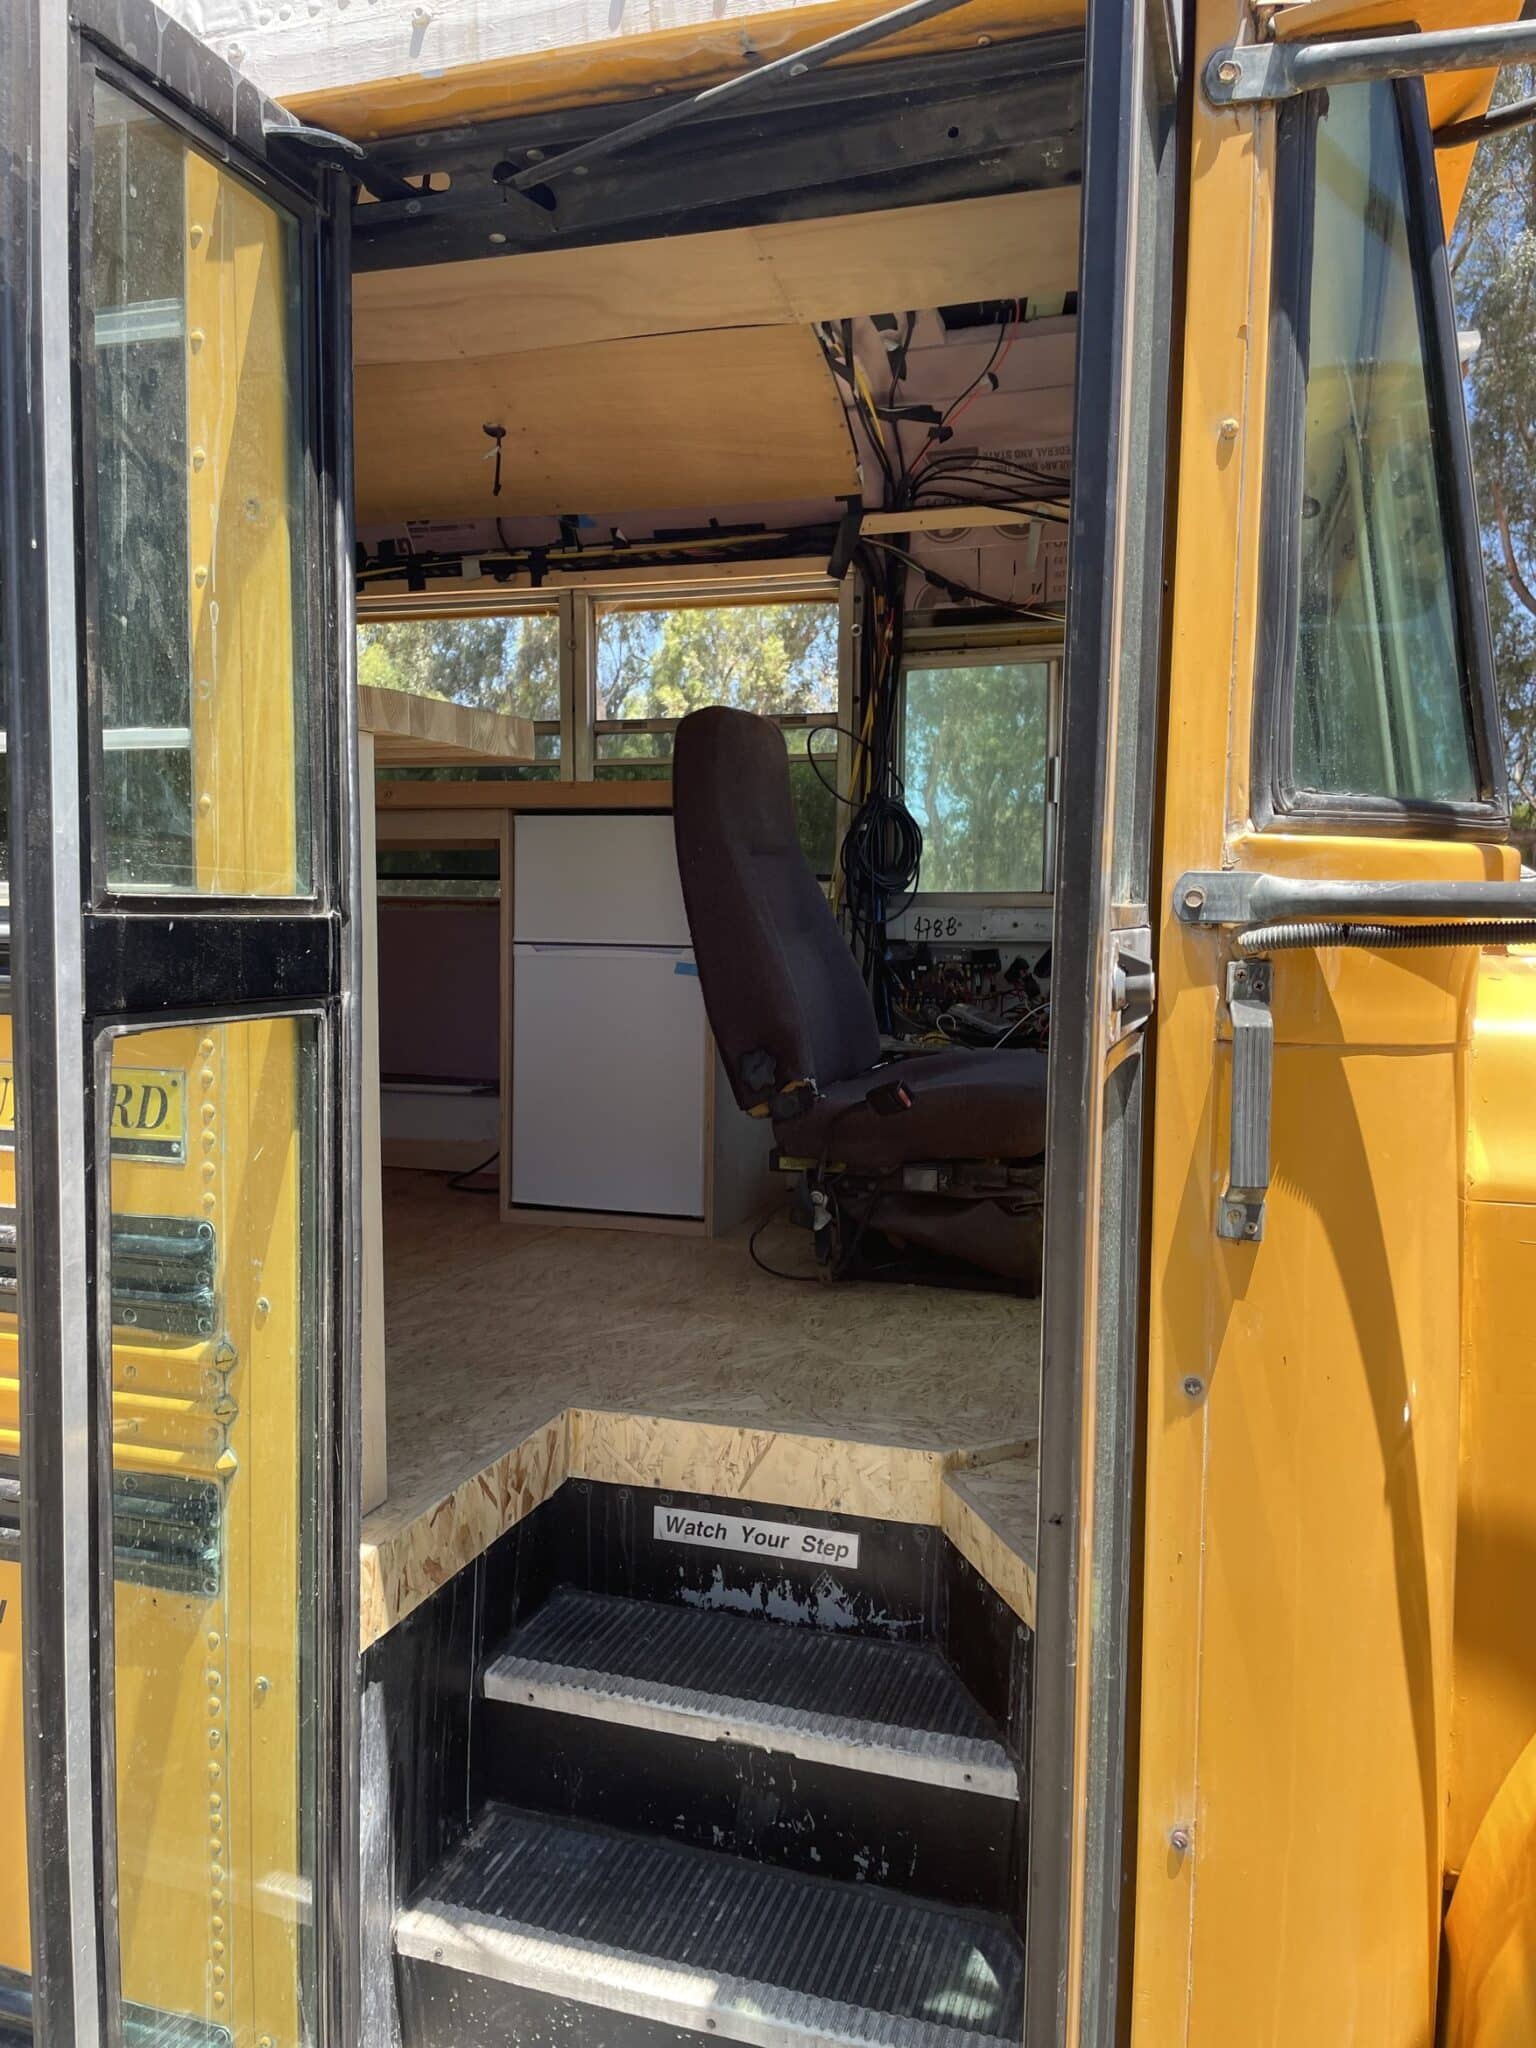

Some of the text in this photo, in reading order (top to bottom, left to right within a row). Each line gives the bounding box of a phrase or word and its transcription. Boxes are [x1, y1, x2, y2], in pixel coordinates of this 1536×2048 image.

[665, 1514, 849, 1562] Watch Your Step
